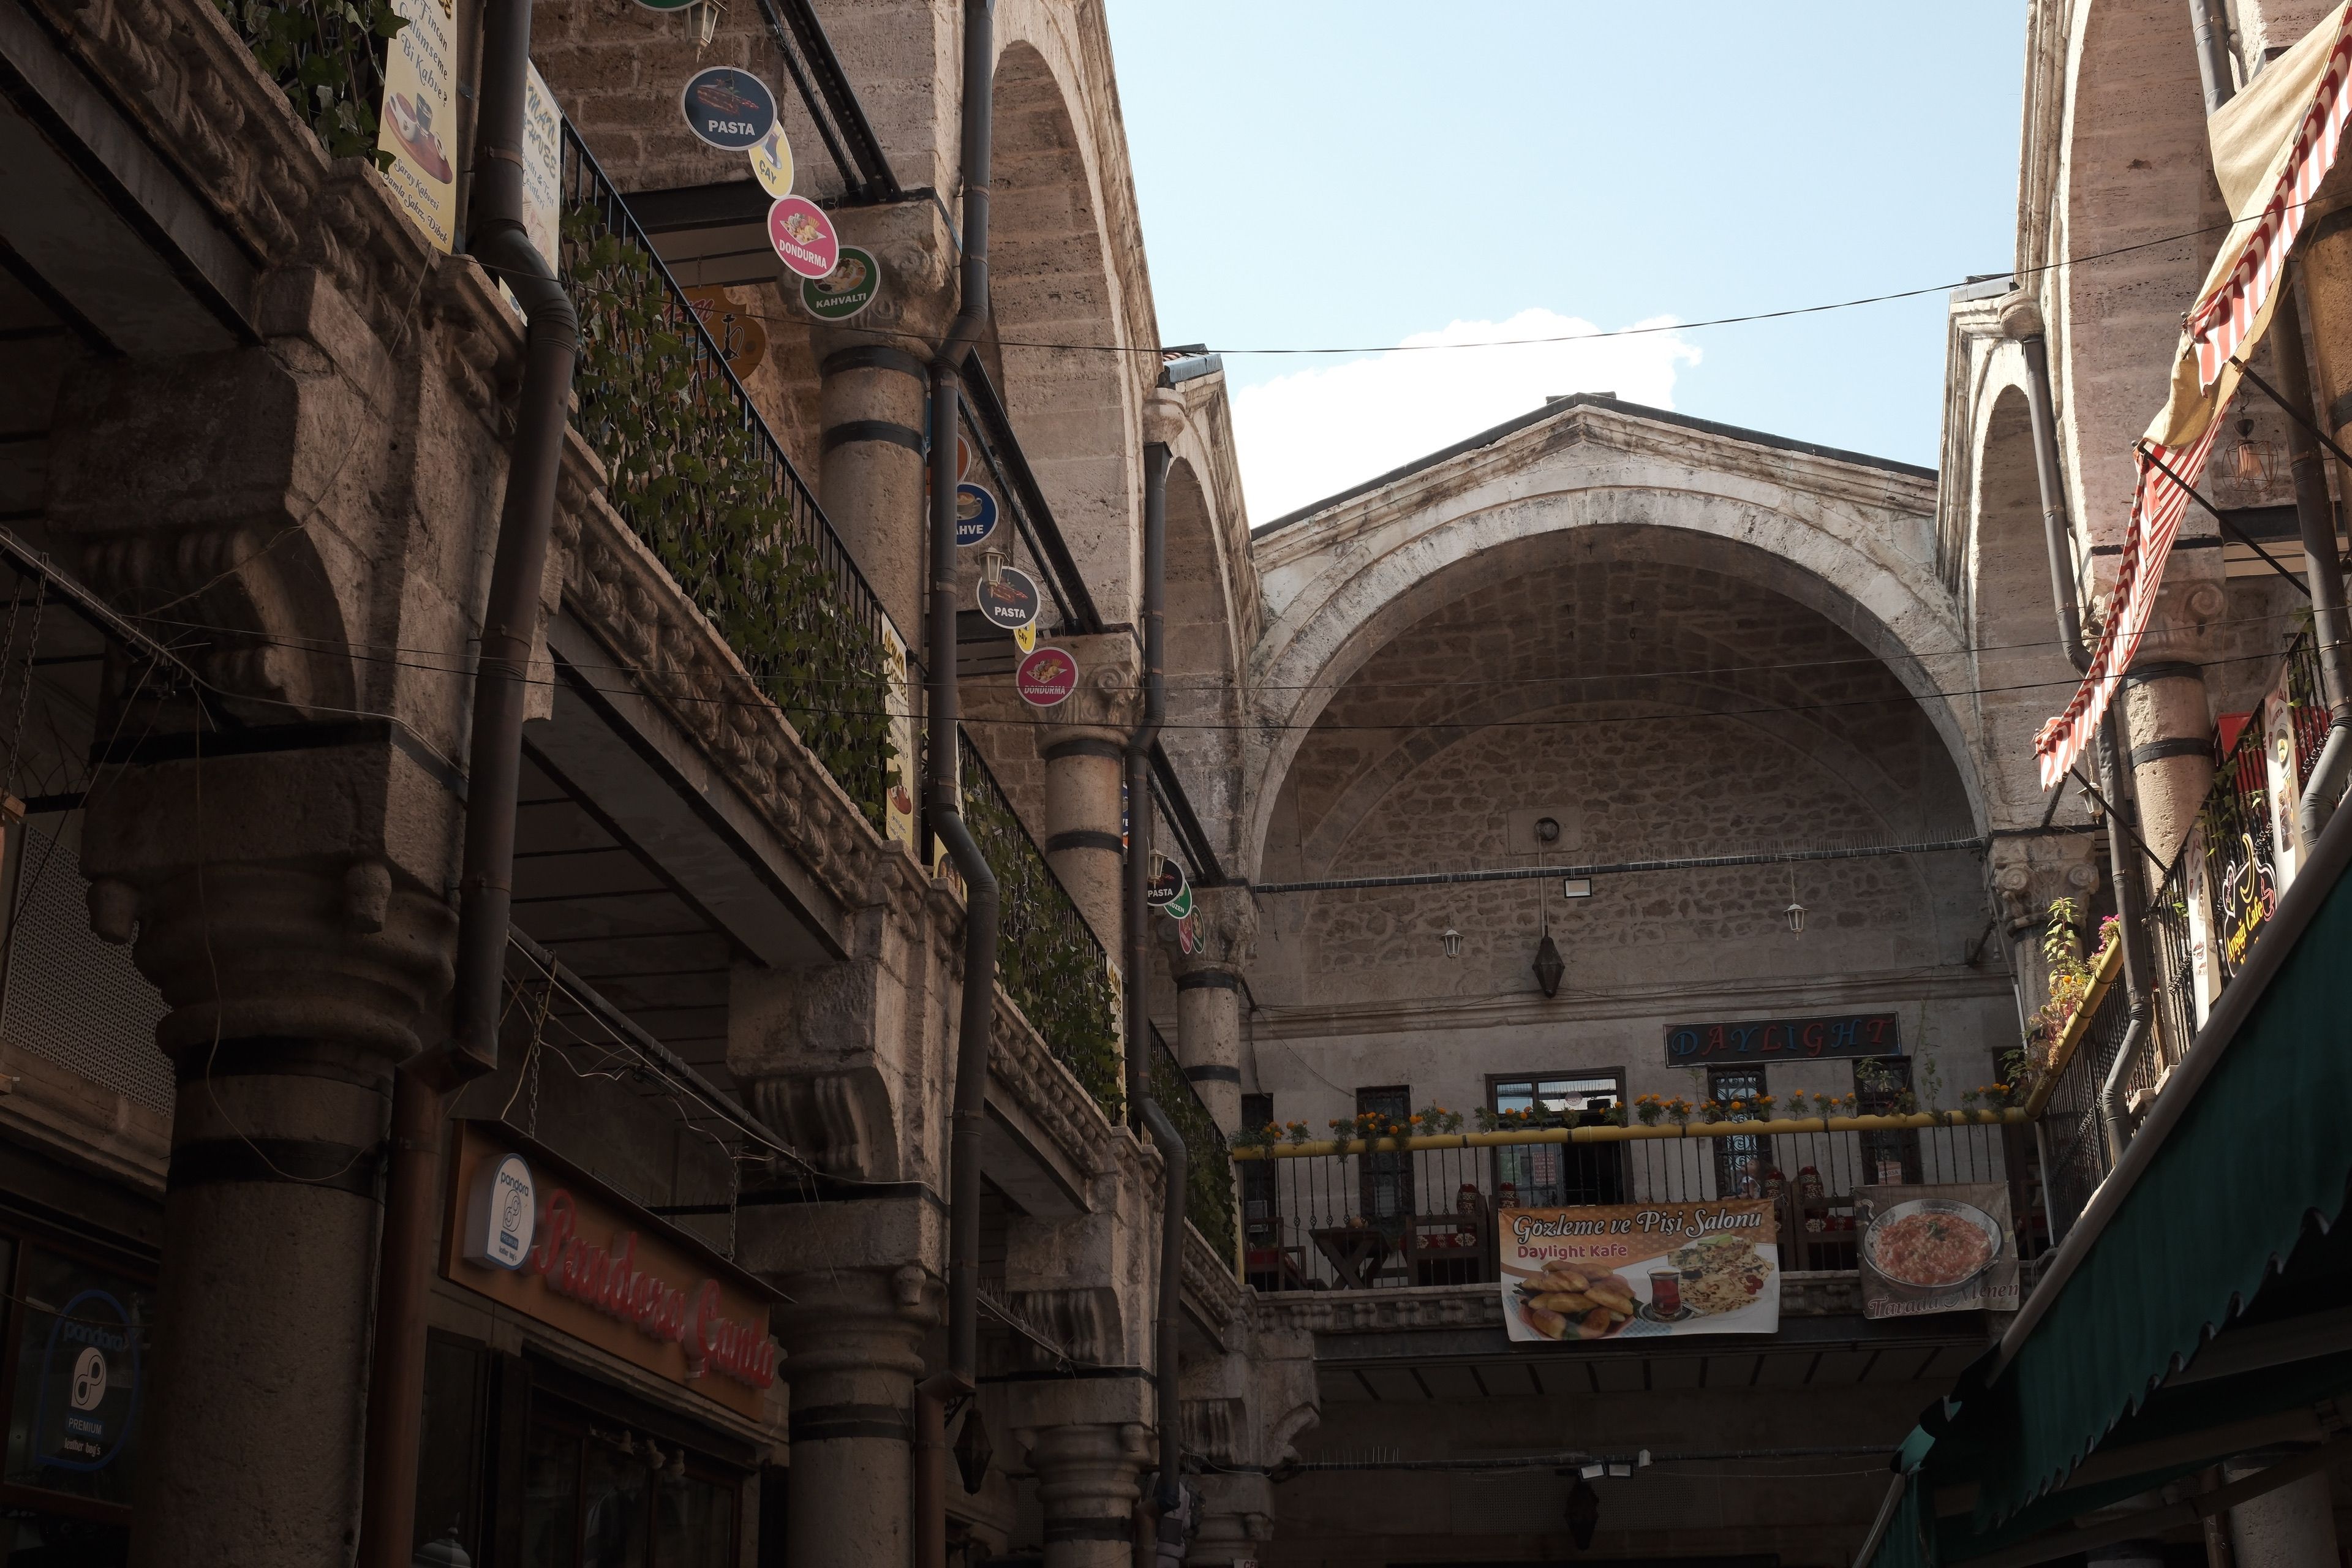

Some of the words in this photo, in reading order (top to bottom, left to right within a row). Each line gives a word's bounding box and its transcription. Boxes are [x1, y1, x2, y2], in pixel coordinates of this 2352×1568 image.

[401, 33, 415, 62] Bi
[528, 85, 555, 146] MAN
[709, 120, 755, 136] PASTA
[394, 159, 415, 186] Saray
[759, 159, 776, 185] ÇAY
[428, 216, 448, 244] Dibek
[779, 239, 827, 270] DONDURMA
[816, 293, 867, 309] KAHVALTI
[957, 524, 984, 535] HVE
[995, 606, 1026, 619] PASTA
[1018, 629, 1027, 644] ÇAY
[1024, 685, 1066, 695] DONDURMA
[1147, 888, 1173, 898] PASTA
[1167, 902, 1185, 914] OZEN
[2245, 895, 2263, 931] Cafe
[1671, 1017, 1893, 1057] DAYLIGHT
[500, 1171, 529, 1197] pandora
[1512, 1213, 1605, 1244] Gözleme
[1610, 1218, 1631, 1235] ve
[1635, 1210, 1683, 1237] Pişi
[1685, 1208, 1763, 1238] Salonu
[501, 1232, 518, 1250] PREMIUM
[1517, 1245, 1585, 1261] Daylight
[1589, 1243, 1628, 1259] Kafe
[532, 1188, 686, 1343] Pandora
[1869, 1295, 1939, 1317] Tavada
[64, 1321, 124, 1352] pandora
[69, 1417, 102, 1436] PREMIUM
[64, 1438, 84, 1452] leather
